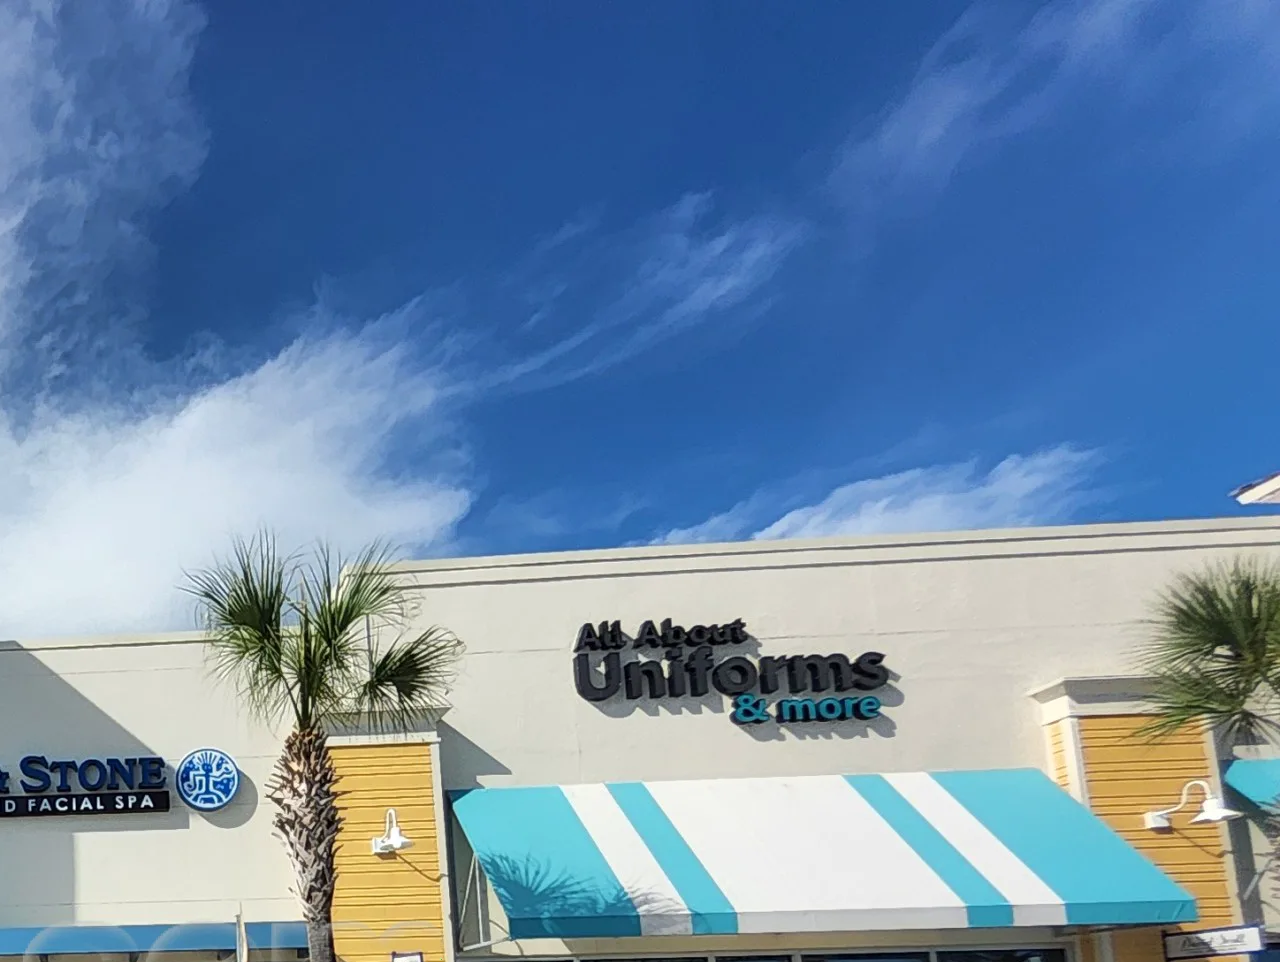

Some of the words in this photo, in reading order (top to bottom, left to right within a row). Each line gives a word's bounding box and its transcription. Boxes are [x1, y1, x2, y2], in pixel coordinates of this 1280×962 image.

[573, 619, 627, 652] All
[633, 617, 748, 650] About
[572, 646, 890, 702] Uniforms
[732, 693, 771, 725] &
[776, 694, 882, 724] more
[19, 755, 167, 794] STONE
[27, 796, 105, 813] FACIAL
[114, 793, 155, 810] SPA
